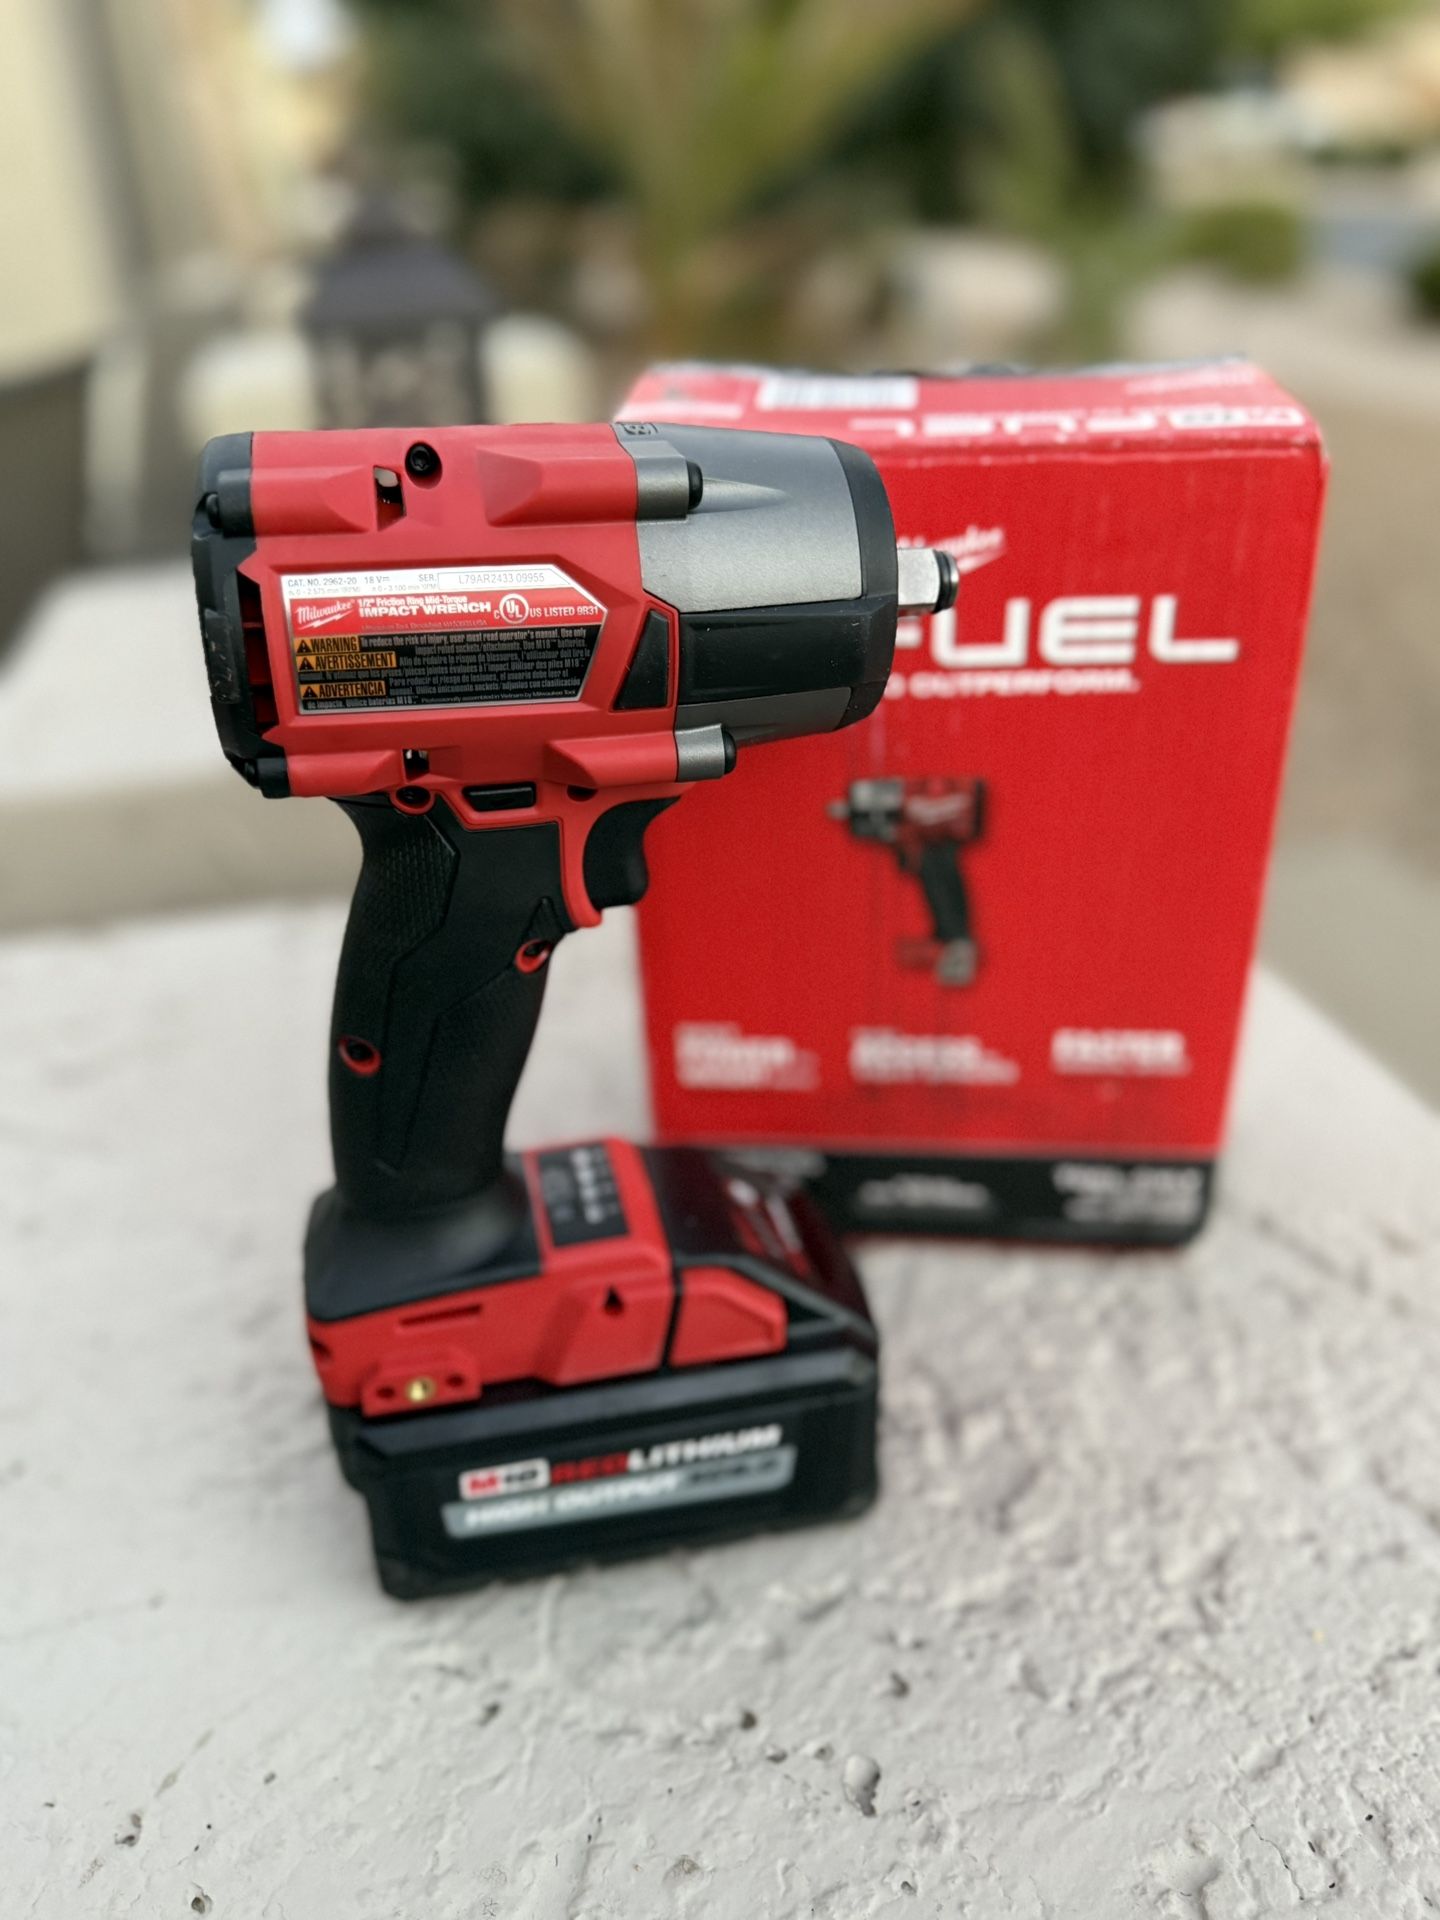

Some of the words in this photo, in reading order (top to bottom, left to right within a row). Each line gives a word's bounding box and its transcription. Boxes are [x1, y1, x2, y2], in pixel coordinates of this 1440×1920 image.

[288, 579, 304, 588] CAT.
[307, 578, 320, 586] NO.
[323, 578, 357, 586] 2962-20
[365, 576, 376, 584] 18
[418, 574, 437, 582] SER.
[376, 598, 406, 606] Friction
[407, 596, 424, 606] Ring
[425, 594, 468, 605] Mid-Torque
[295, 602, 353, 624] Milwaukee
[359, 606, 420, 618] IMPACT
[422, 602, 491, 615] WRENCH
[530, 606, 542, 617] US
[544, 606, 574, 616] LISTED
[310, 638, 357, 653] WARNING
[316, 652, 394, 670] AVERTISSEMENT
[319, 680, 384, 698] ADVERTENCIA
